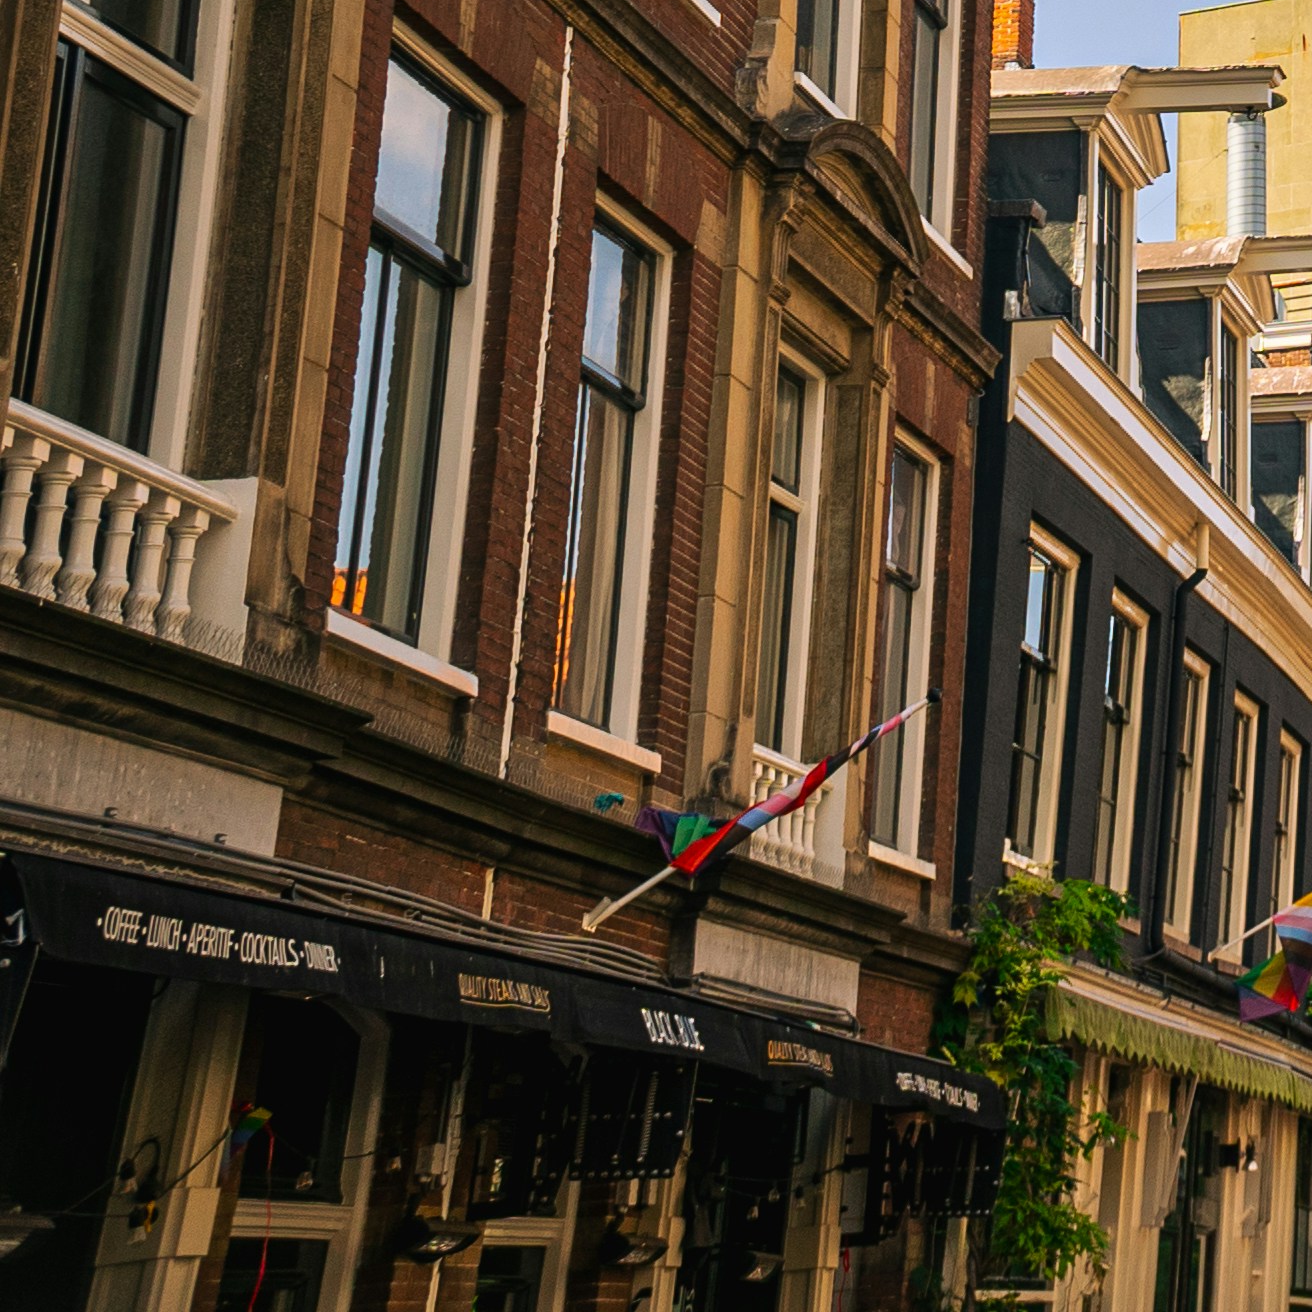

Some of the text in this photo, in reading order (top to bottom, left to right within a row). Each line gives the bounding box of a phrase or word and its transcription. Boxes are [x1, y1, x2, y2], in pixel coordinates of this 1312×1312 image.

[103, 906, 143, 943] COFFEE
[146, 914, 183, 951] LUNCH
[186, 922, 235, 959] APERITIF
[240, 931, 299, 966] COCKTAILS
